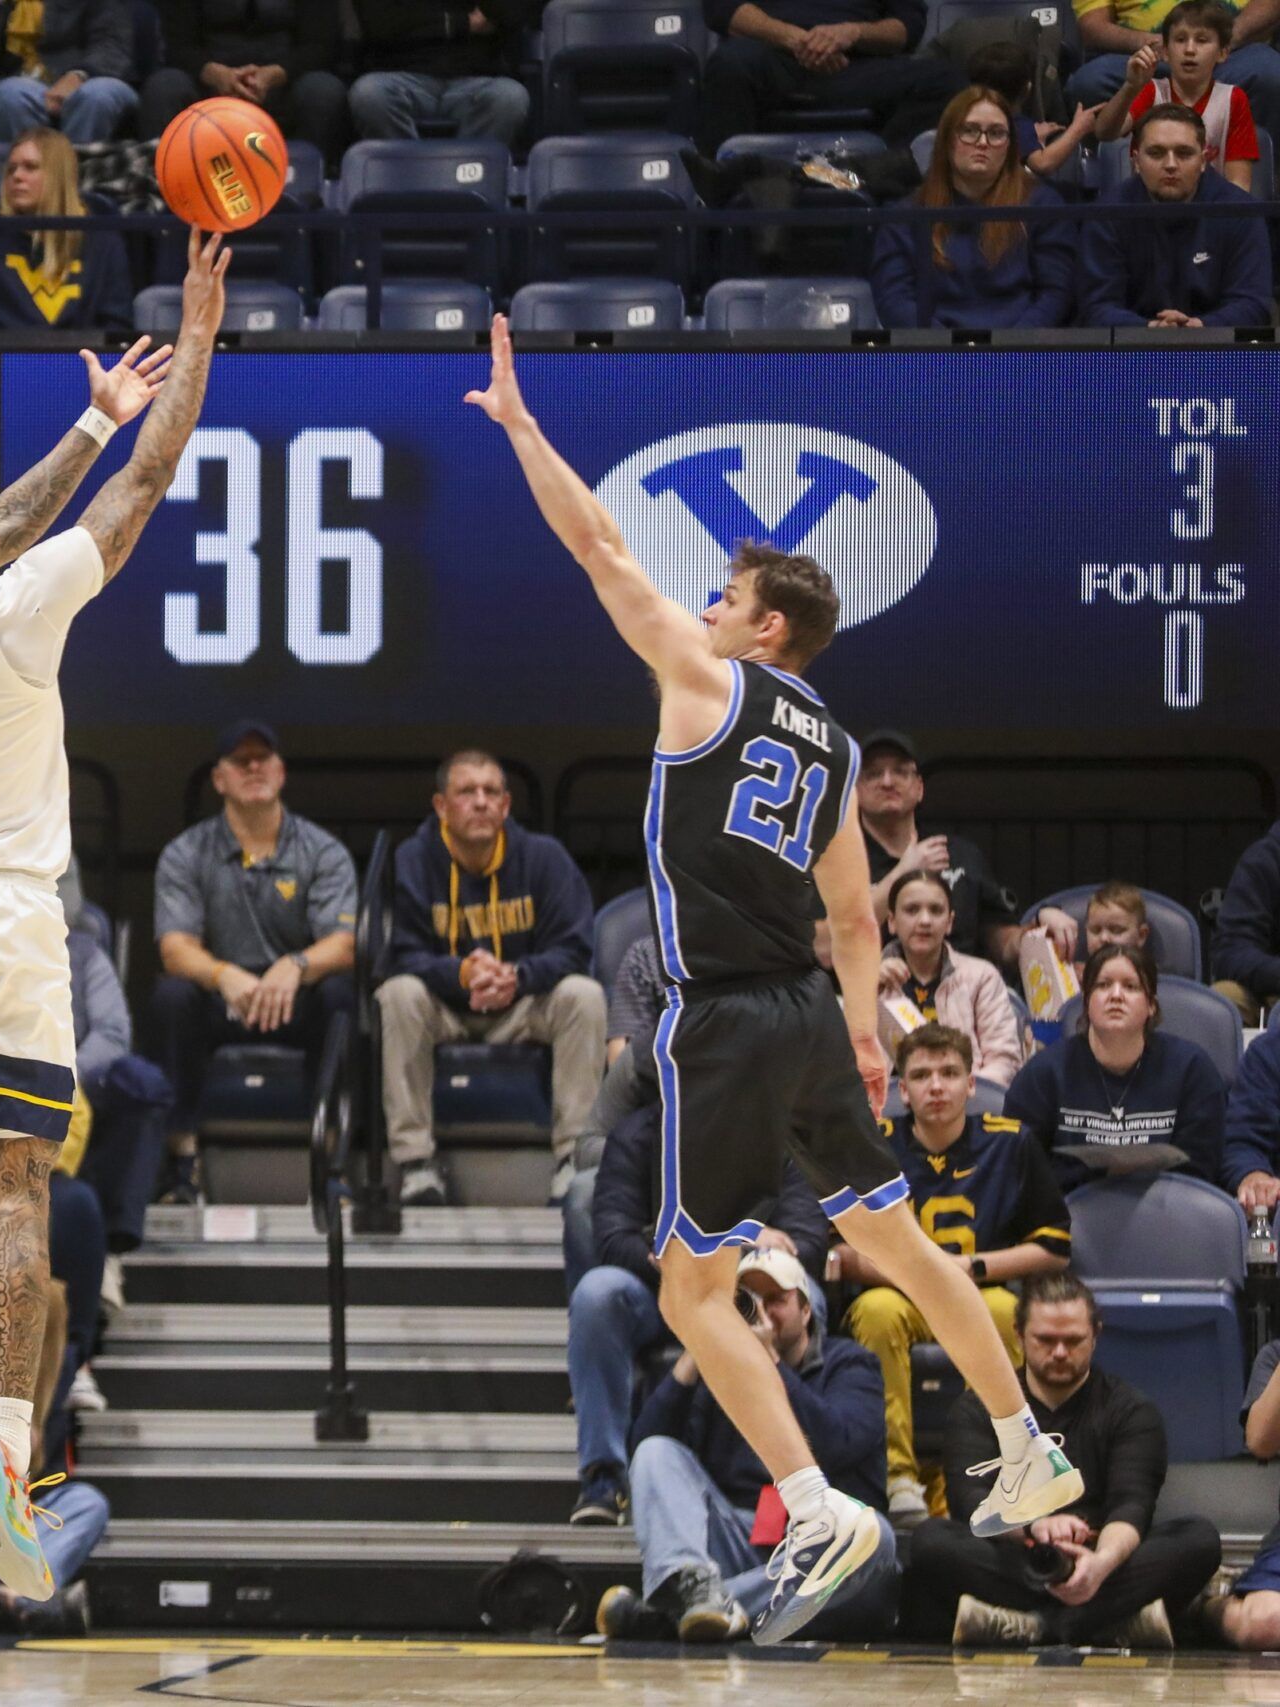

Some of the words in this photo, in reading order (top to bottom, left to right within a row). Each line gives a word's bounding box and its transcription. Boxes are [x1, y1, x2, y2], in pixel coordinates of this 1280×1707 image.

[211, 151, 252, 219] ELITE
[1148, 397, 1249, 437] TOL
[1170, 442, 1215, 541] 3
[164, 427, 384, 665] 36
[1081, 563, 1245, 606] FOULS
[1164, 610, 1204, 709] 0
[771, 695, 832, 753] KNELL
[723, 735, 829, 873] 21
[1064, 1115, 1084, 1127] WEST
[1086, 1117, 1123, 1131] VIRGINIA
[1125, 1116, 1176, 1130] UNIVERSITY
[1085, 1133, 1120, 1146] COLLEGE
[1121, 1135, 1131, 1146] OF
[1132, 1134, 1149, 1145] LAW
